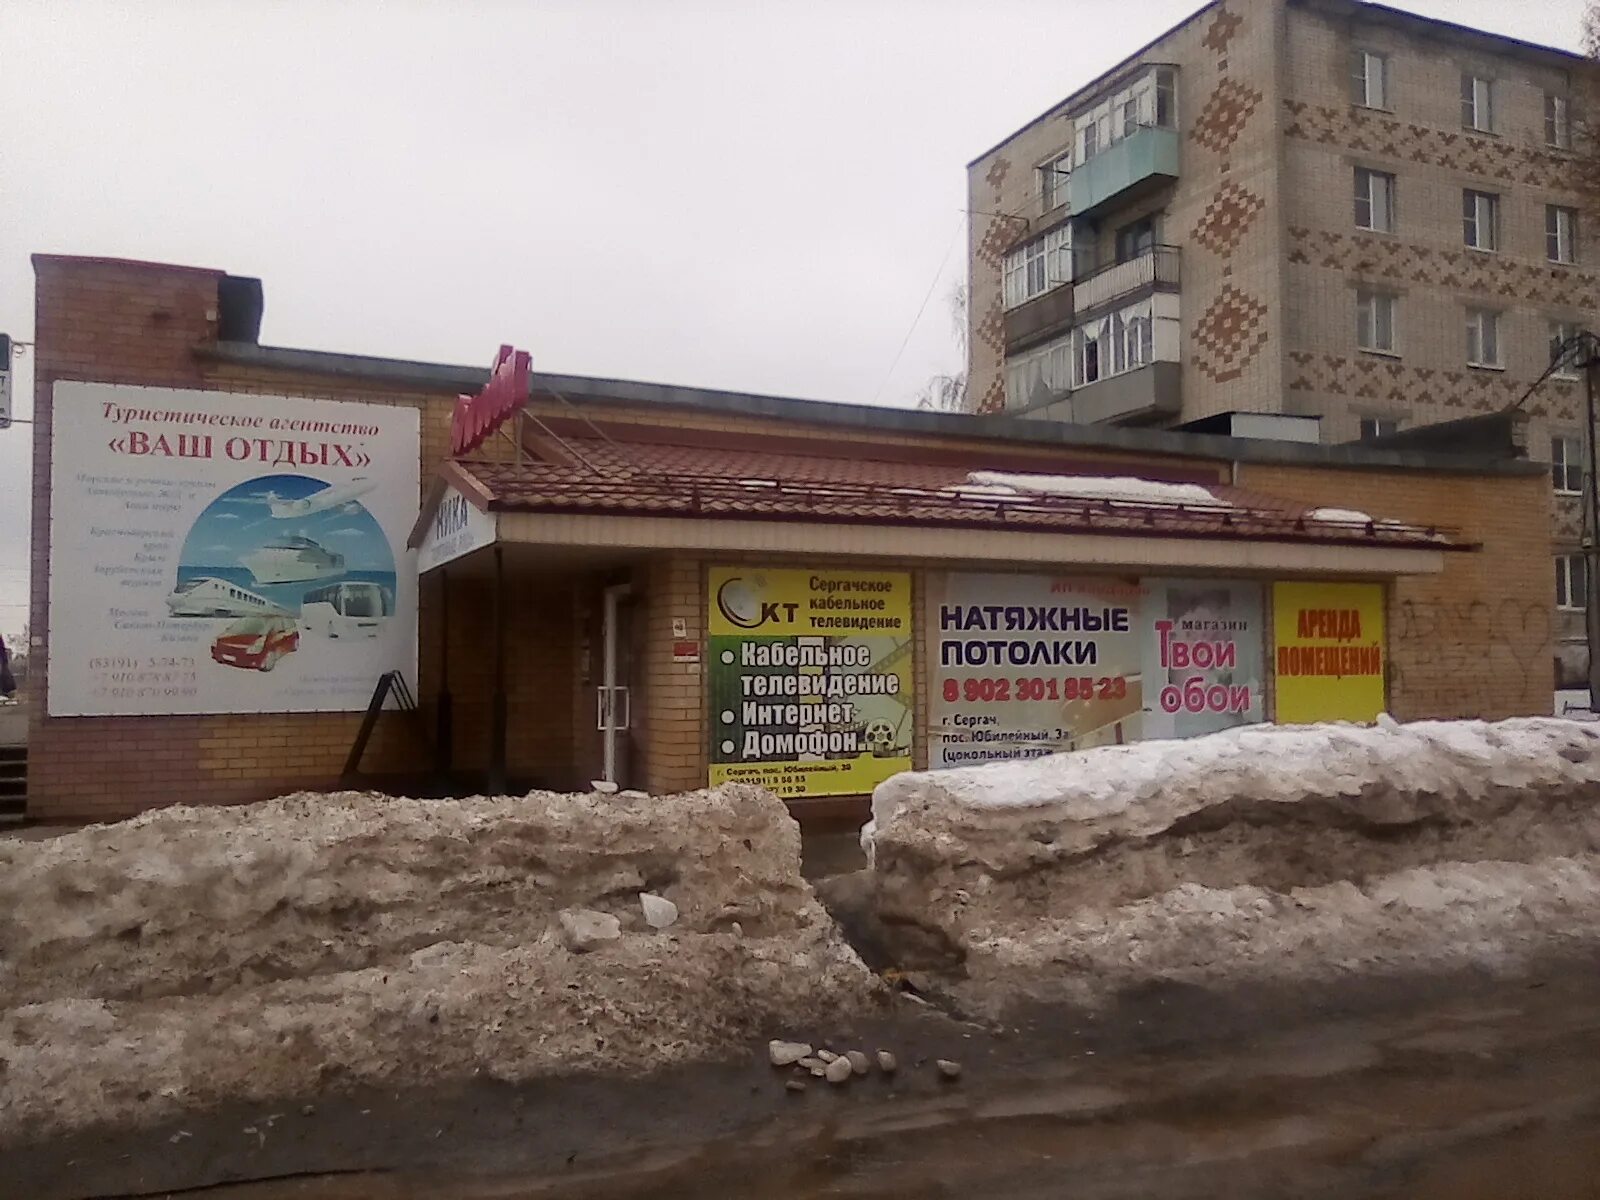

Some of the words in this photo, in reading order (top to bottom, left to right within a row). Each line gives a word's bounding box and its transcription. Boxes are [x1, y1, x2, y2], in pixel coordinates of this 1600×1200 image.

[102, 401, 264, 430] Туристическое
[269, 414, 380, 437] агентство
[107, 431, 213, 459] «ВАШ
[808, 576, 893, 594] Сергачское
[808, 595, 886, 610] кабельное
[809, 615, 902, 630] телевидение
[940, 605, 1129, 631] НАТЯЖНЫЕ
[1181, 620, 1247, 631] магазин
[1296, 608, 1362, 643] АРЕНДА
[740, 641, 871, 667] Кабельное
[941, 641, 1097, 665] ПОТОЛКИ
[1154, 620, 1235, 668] Твои
[1277, 641, 1381, 680] ПОМЕЩЕНИЙ
[740, 673, 900, 698] телевидение
[943, 678, 959, 702] 8
[963, 678, 1010, 702] 902
[1015, 677, 1060, 701] 301
[1160, 676, 1250, 713] обои
[741, 701, 854, 726] Интернет
[942, 715, 951, 725] г.
[741, 730, 858, 759] Домофон
[942, 733, 968, 743] пос.
[942, 748, 1021, 762] (цокольный
